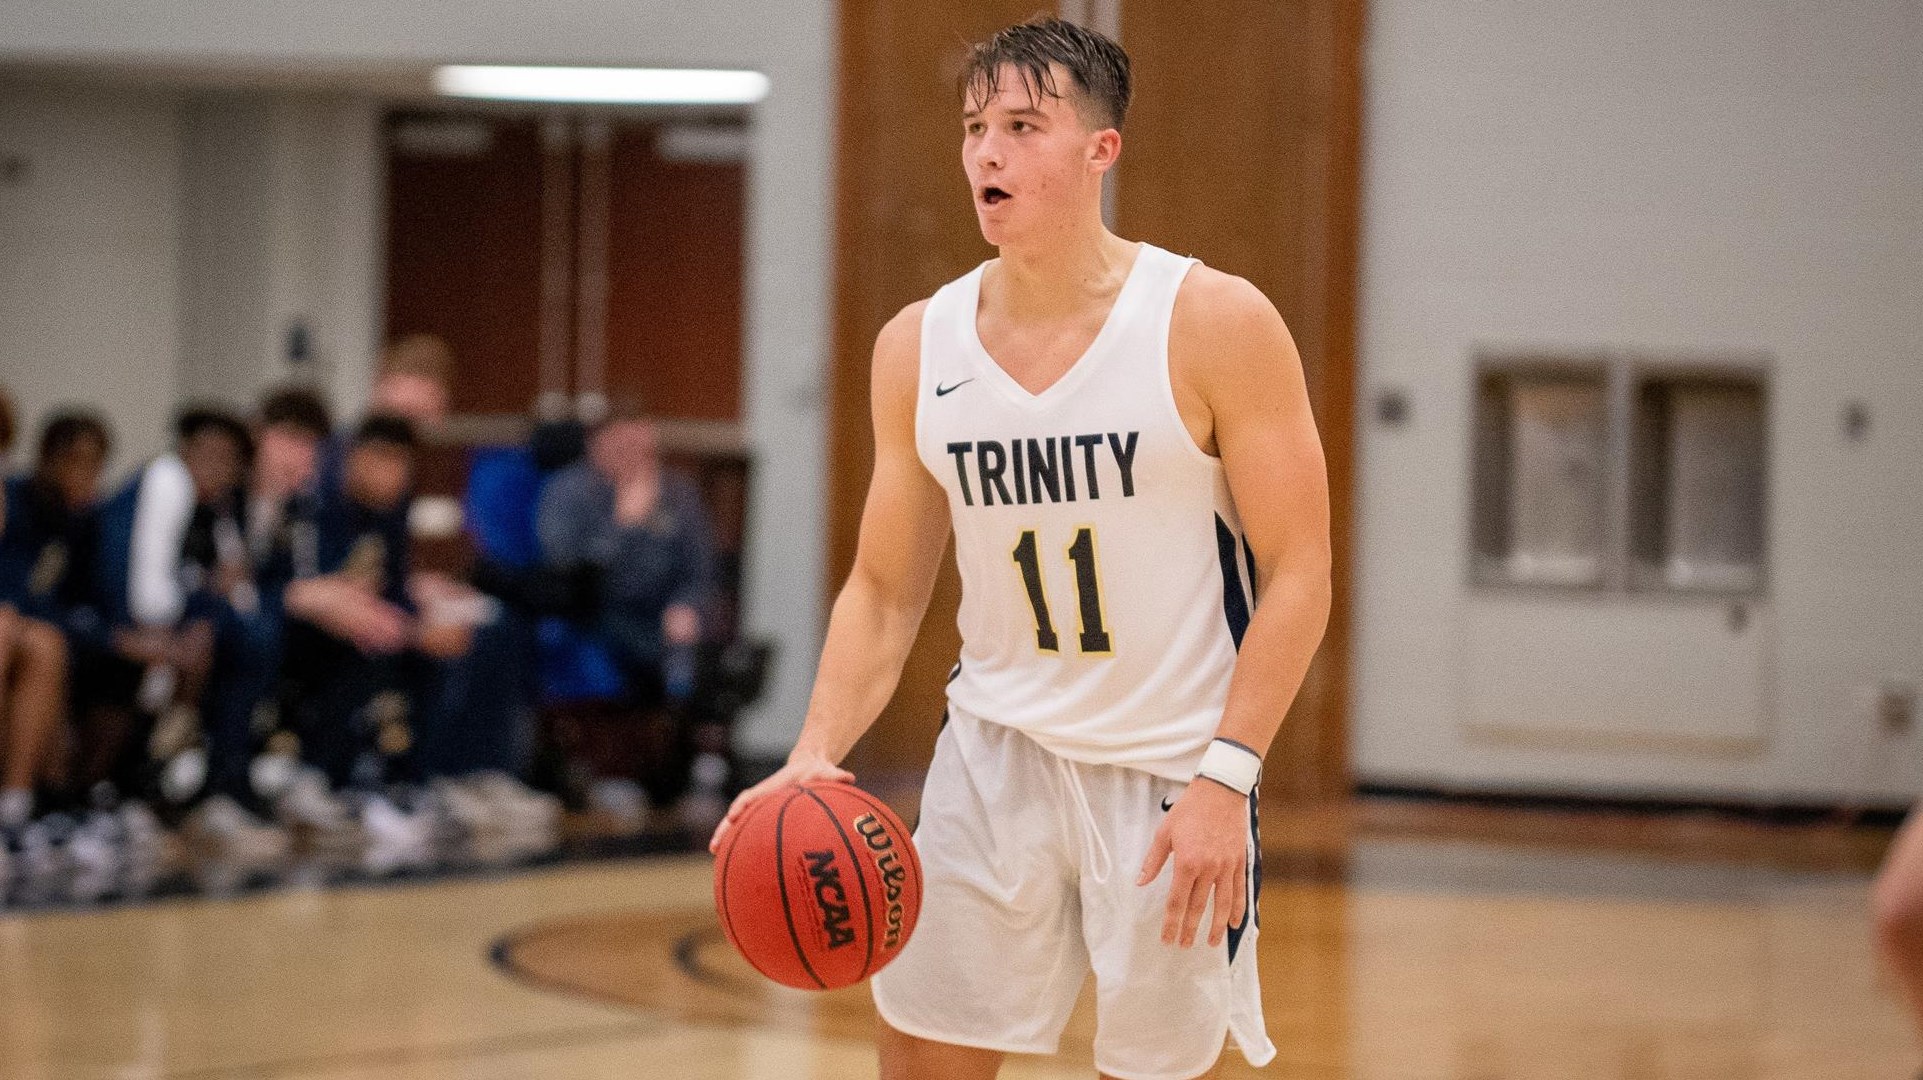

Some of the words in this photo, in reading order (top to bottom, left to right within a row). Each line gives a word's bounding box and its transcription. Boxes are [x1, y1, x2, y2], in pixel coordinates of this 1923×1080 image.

[947, 431, 1139, 506] TRINITY
[1010, 525, 1115, 655] 11
[803, 849, 856, 950] NCAA
[853, 812, 906, 951] Wilson
